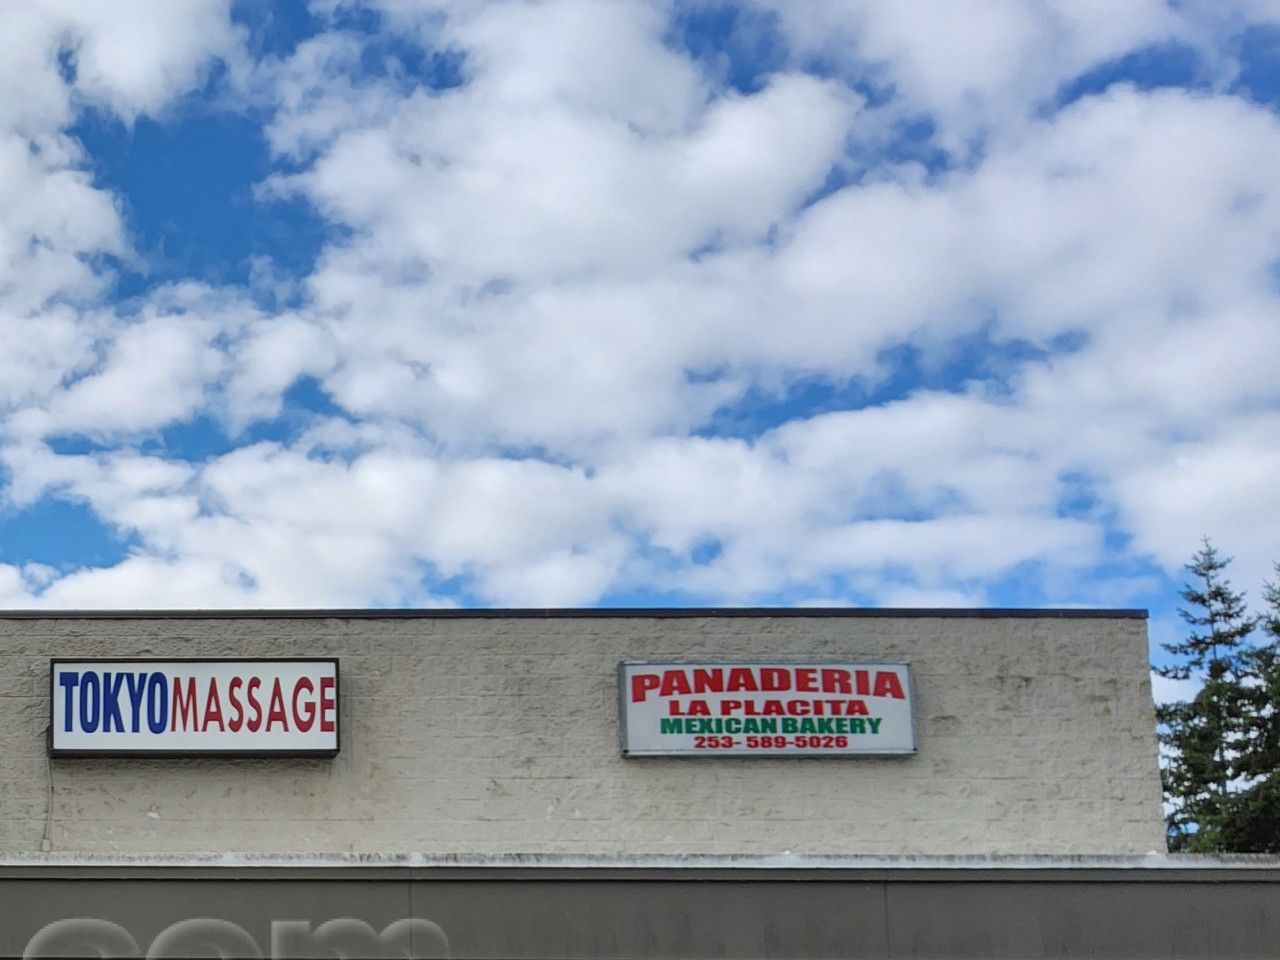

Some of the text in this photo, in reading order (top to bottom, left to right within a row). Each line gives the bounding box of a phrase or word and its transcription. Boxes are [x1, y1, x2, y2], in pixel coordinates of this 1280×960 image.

[630, 667, 906, 703] PANADERIA
[669, 700, 870, 716] LA PLACITA
[659, 718, 883, 735] MEXICAN BAKERY
